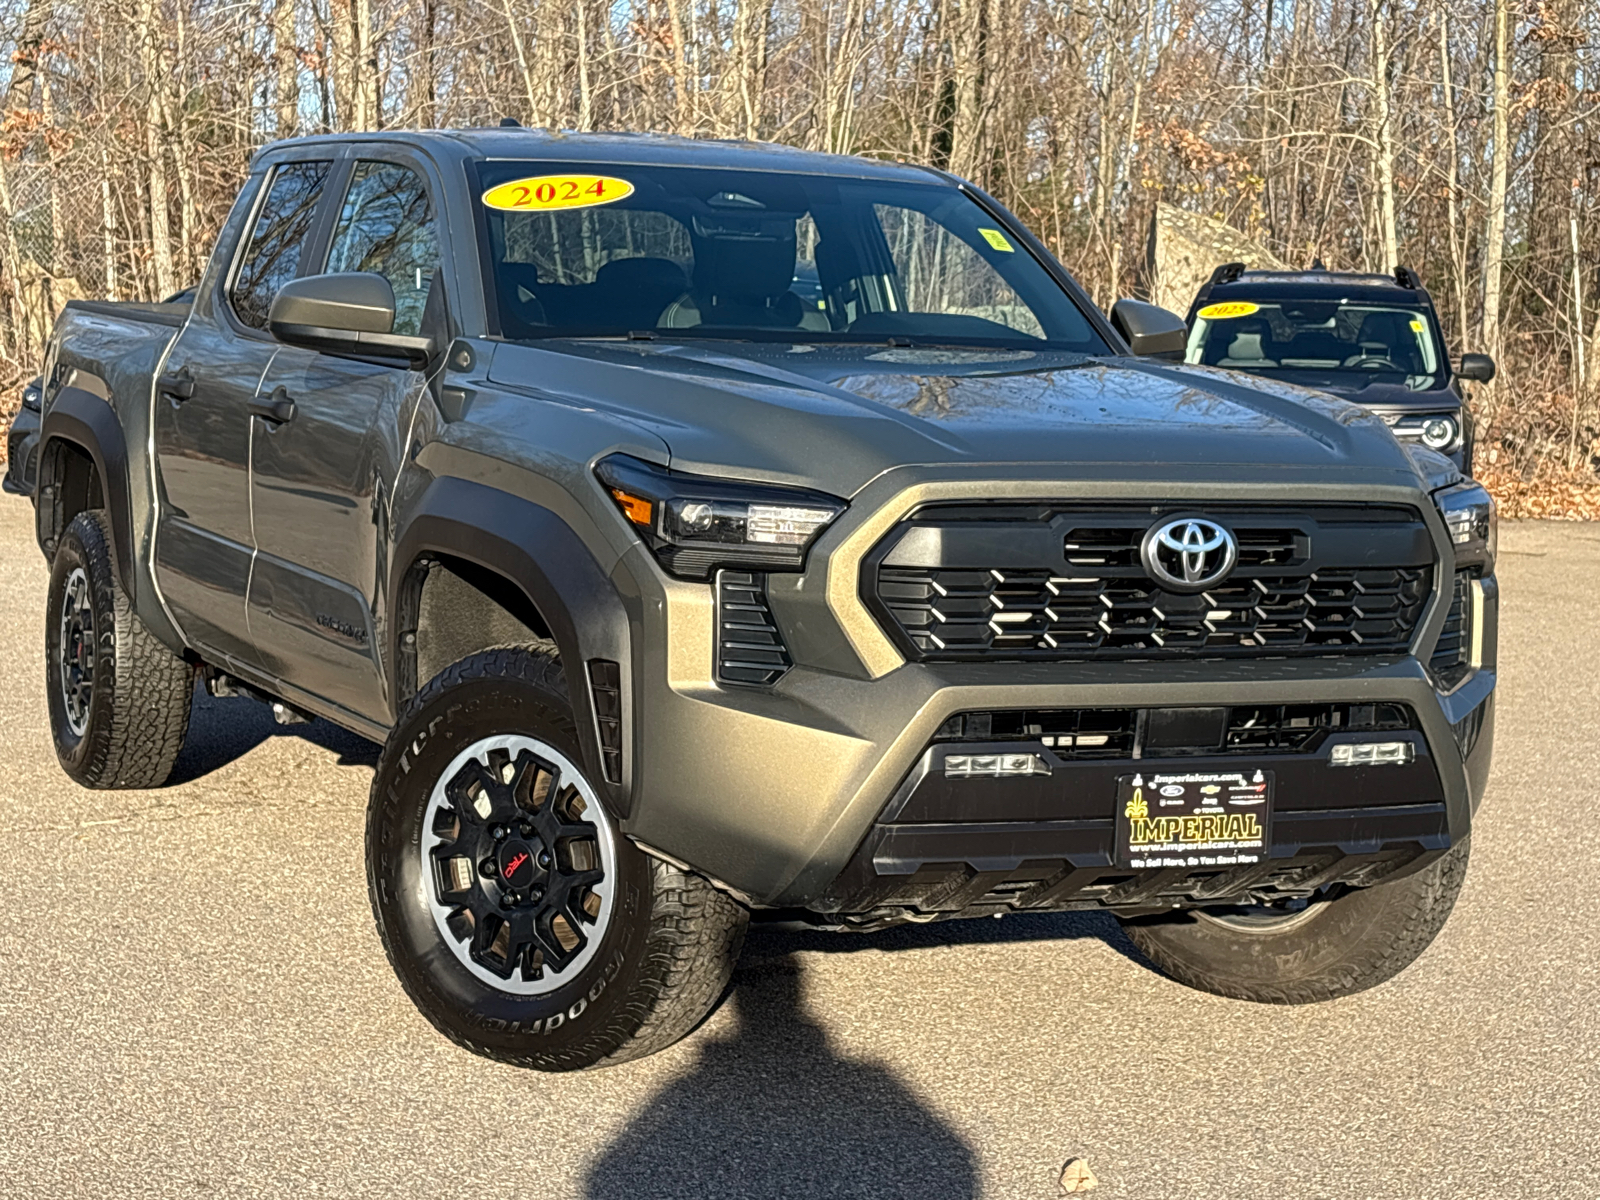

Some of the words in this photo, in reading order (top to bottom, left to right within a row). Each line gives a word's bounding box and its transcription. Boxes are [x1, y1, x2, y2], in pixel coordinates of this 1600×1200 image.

[511, 179, 606, 207] 2024
[1206, 304, 1248, 316] 2025
[1130, 814, 1262, 843] IMPERIAL
[1129, 840, 1262, 852] www.imperialcars.com
[504, 852, 529, 879] TRD
[1131, 859, 1145, 868] We
[1146, 858, 1162, 867] Sell
[1163, 858, 1186, 867] More,
[1187, 857, 1199, 866] So
[1200, 856, 1216, 865] You
[1216, 855, 1237, 864] Save
[1238, 855, 1258, 863] More
